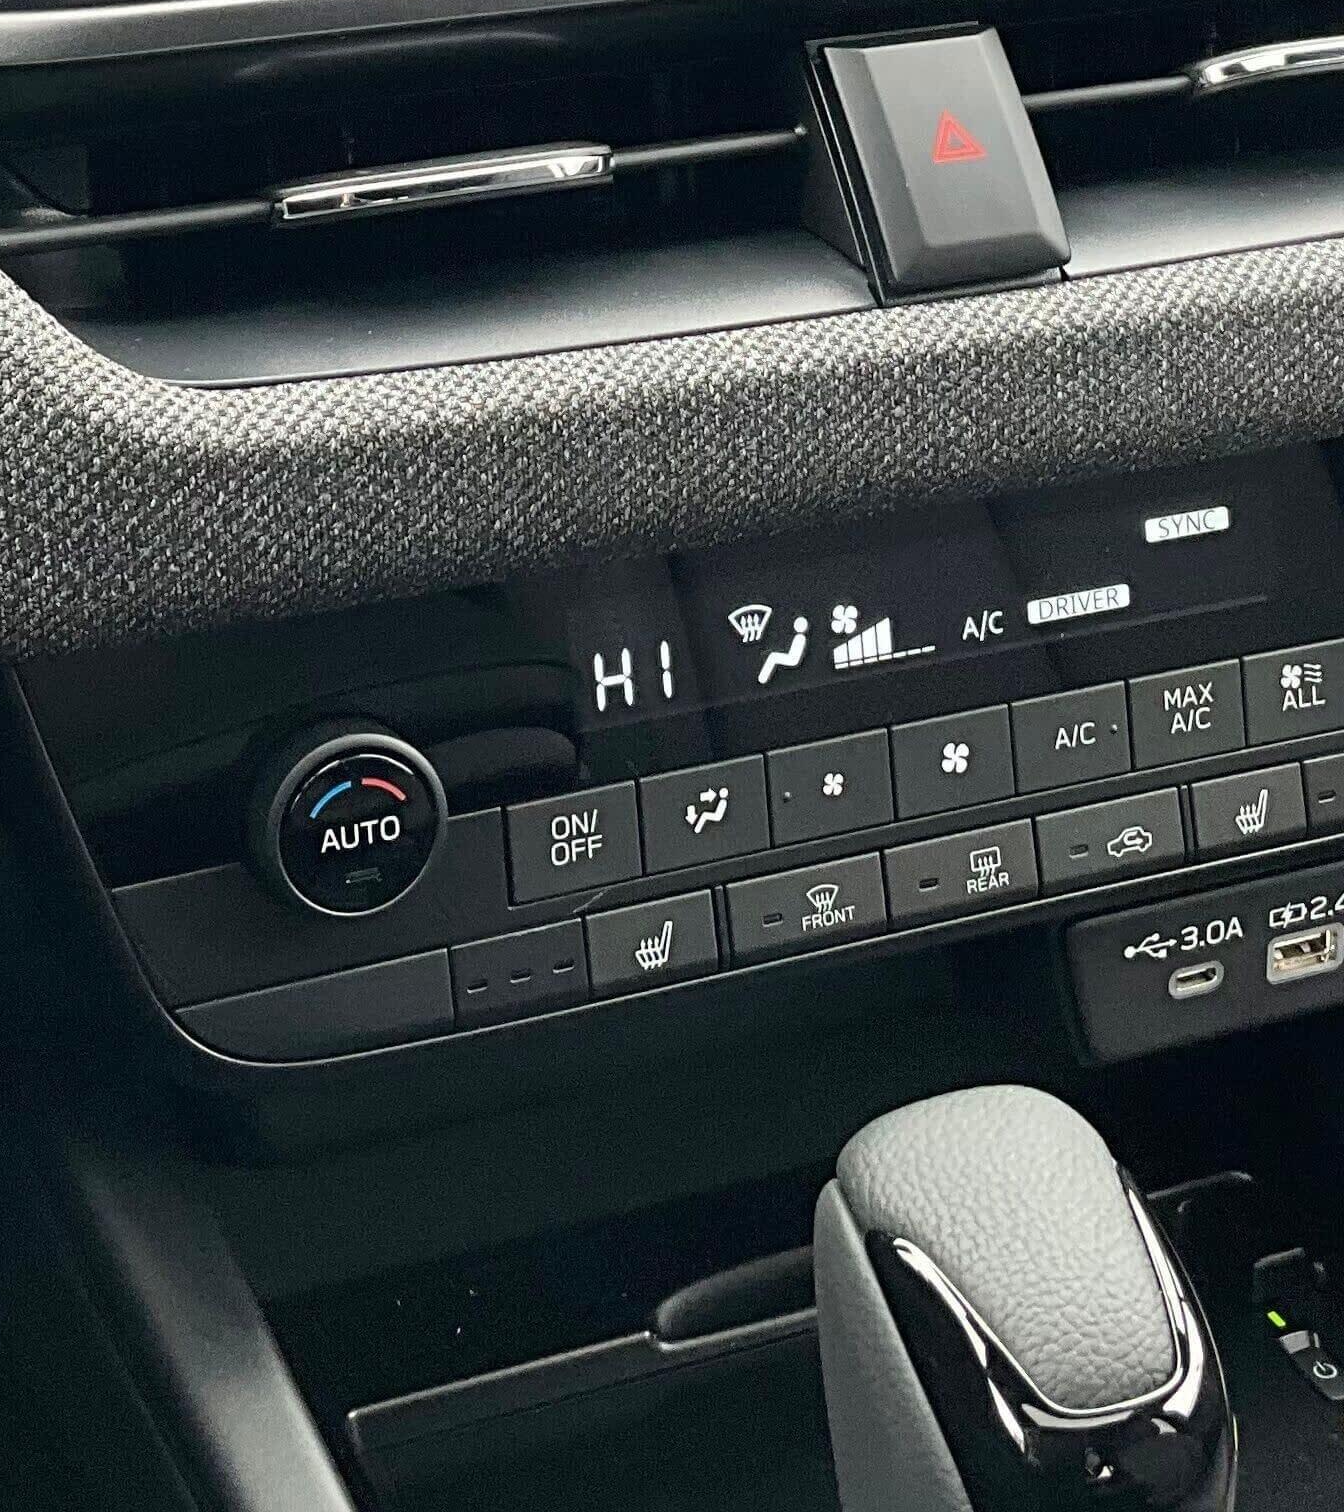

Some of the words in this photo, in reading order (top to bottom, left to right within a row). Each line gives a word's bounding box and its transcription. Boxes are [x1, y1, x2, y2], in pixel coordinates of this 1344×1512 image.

[1156, 510, 1218, 538] SYNC
[1038, 587, 1121, 621] DRIVER
[962, 609, 1005, 642] A/C
[1163, 683, 1214, 710] MAX
[1281, 686, 1326, 712] ALL
[1054, 720, 1096, 751] A/C
[1170, 706, 1212, 736] A/C
[320, 814, 401, 854] AUTO
[550, 808, 600, 840] ON/
[550, 834, 603, 866] OFF
[966, 872, 1010, 895] REAR
[801, 905, 855, 931] FRONT
[1179, 917, 1244, 953] 3.0A
